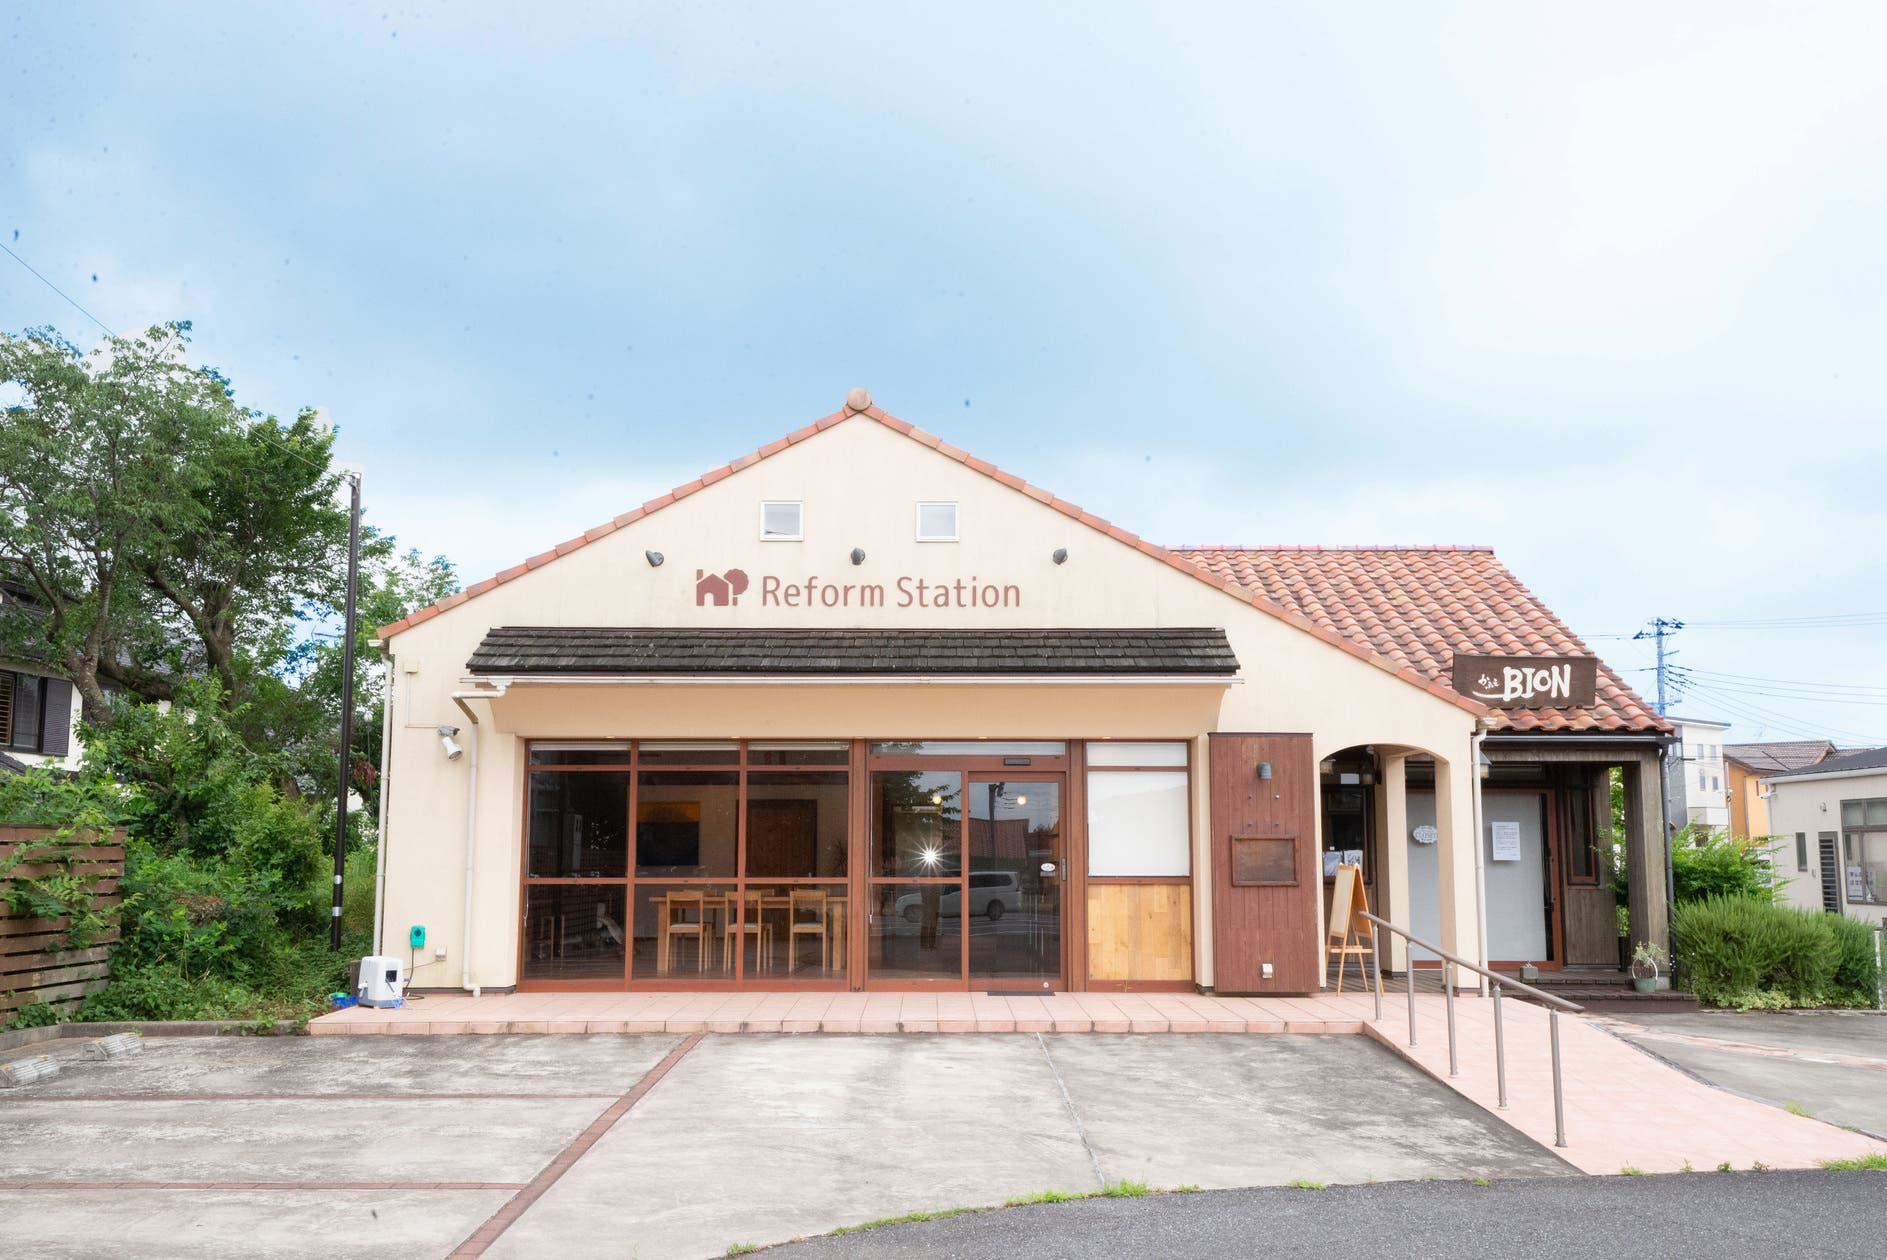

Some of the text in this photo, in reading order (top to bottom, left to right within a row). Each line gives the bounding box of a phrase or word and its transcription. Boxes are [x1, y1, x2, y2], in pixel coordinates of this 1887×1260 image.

[763, 576, 1020, 608] Reform Station
[1503, 664, 1571, 702] BION
